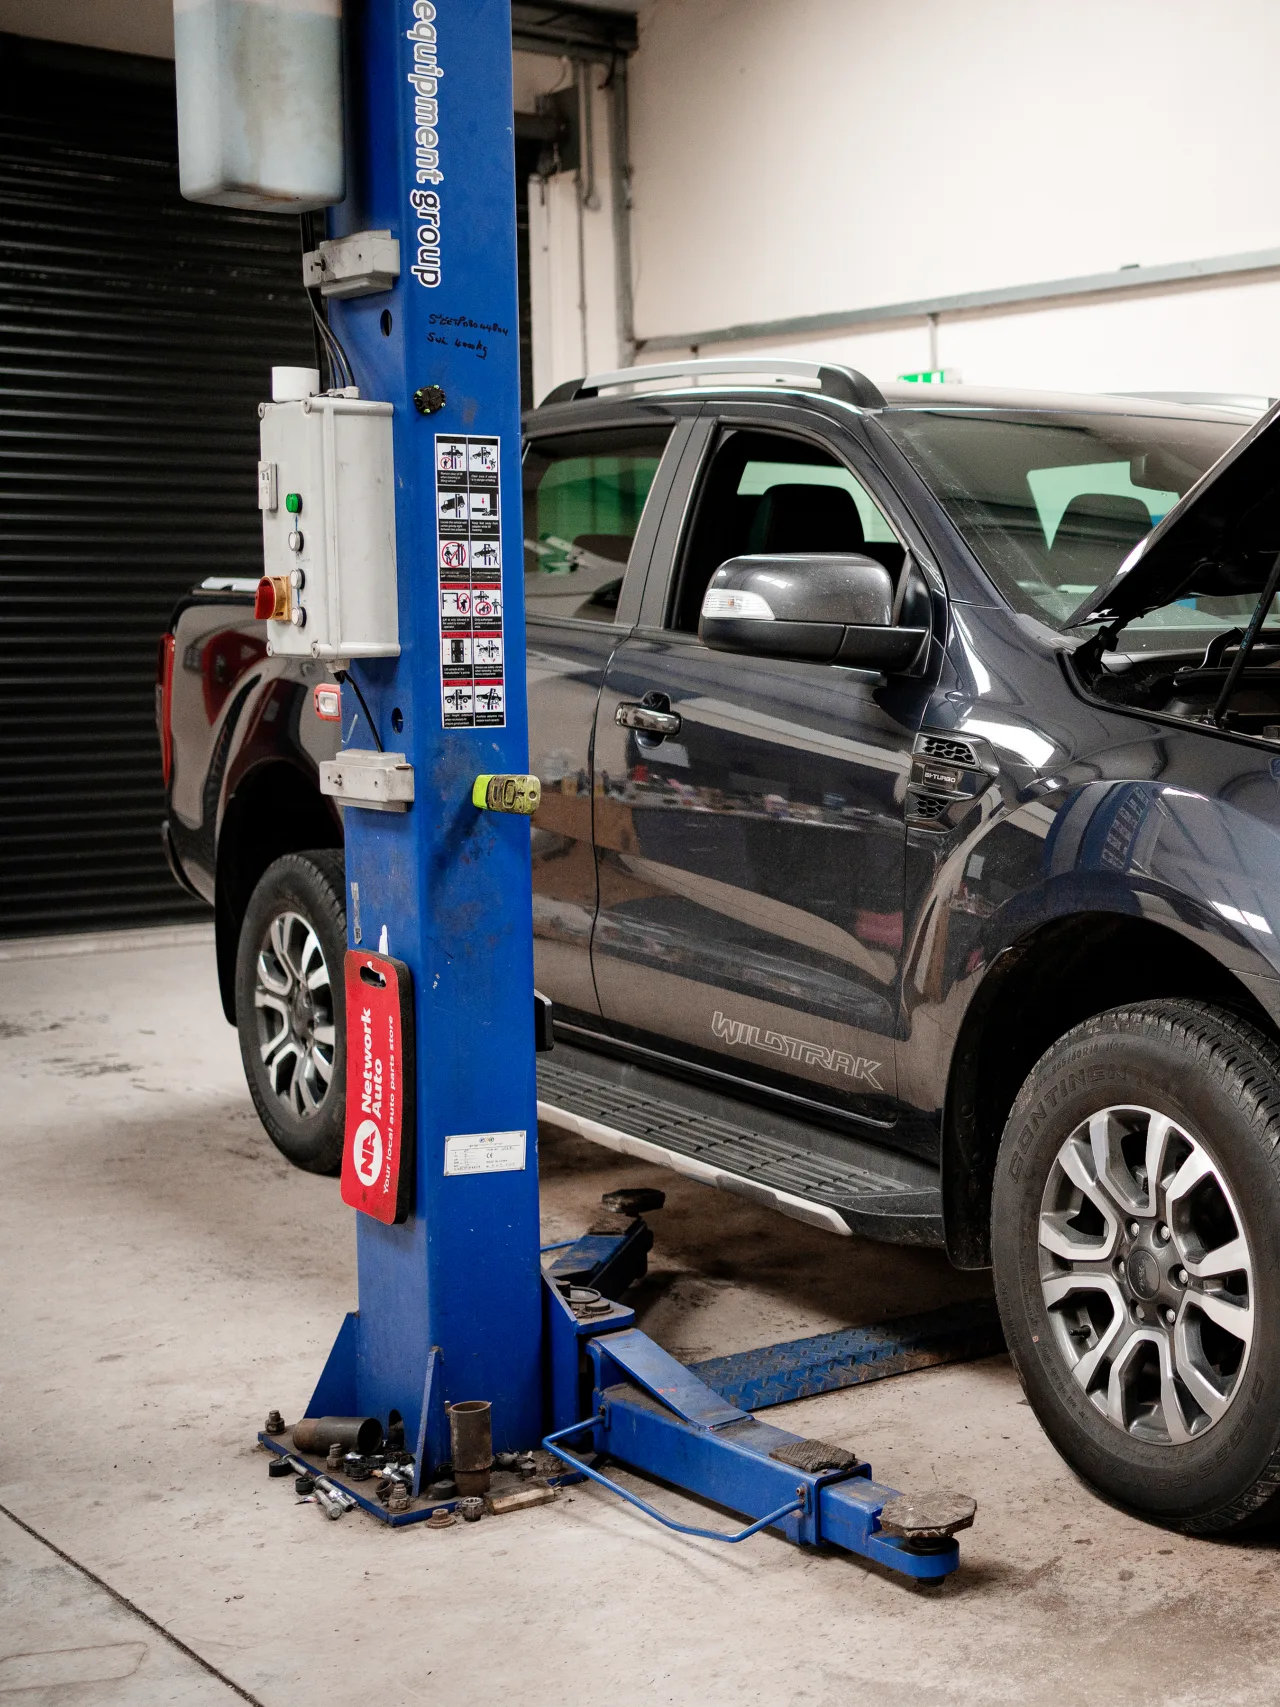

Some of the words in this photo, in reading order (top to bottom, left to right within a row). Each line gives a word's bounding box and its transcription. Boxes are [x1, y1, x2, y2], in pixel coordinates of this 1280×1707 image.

[407, 0, 444, 185] equipment
[410, 189, 441, 288] group
[924, 771, 956, 783] BI-TURBO
[361, 1007, 372, 1114] Network
[711, 1010, 884, 1091] WILDTRAK
[371, 1058, 383, 1120] Auto
[360, 1129, 378, 1177] NA
[382, 1162, 391, 1195] Your
